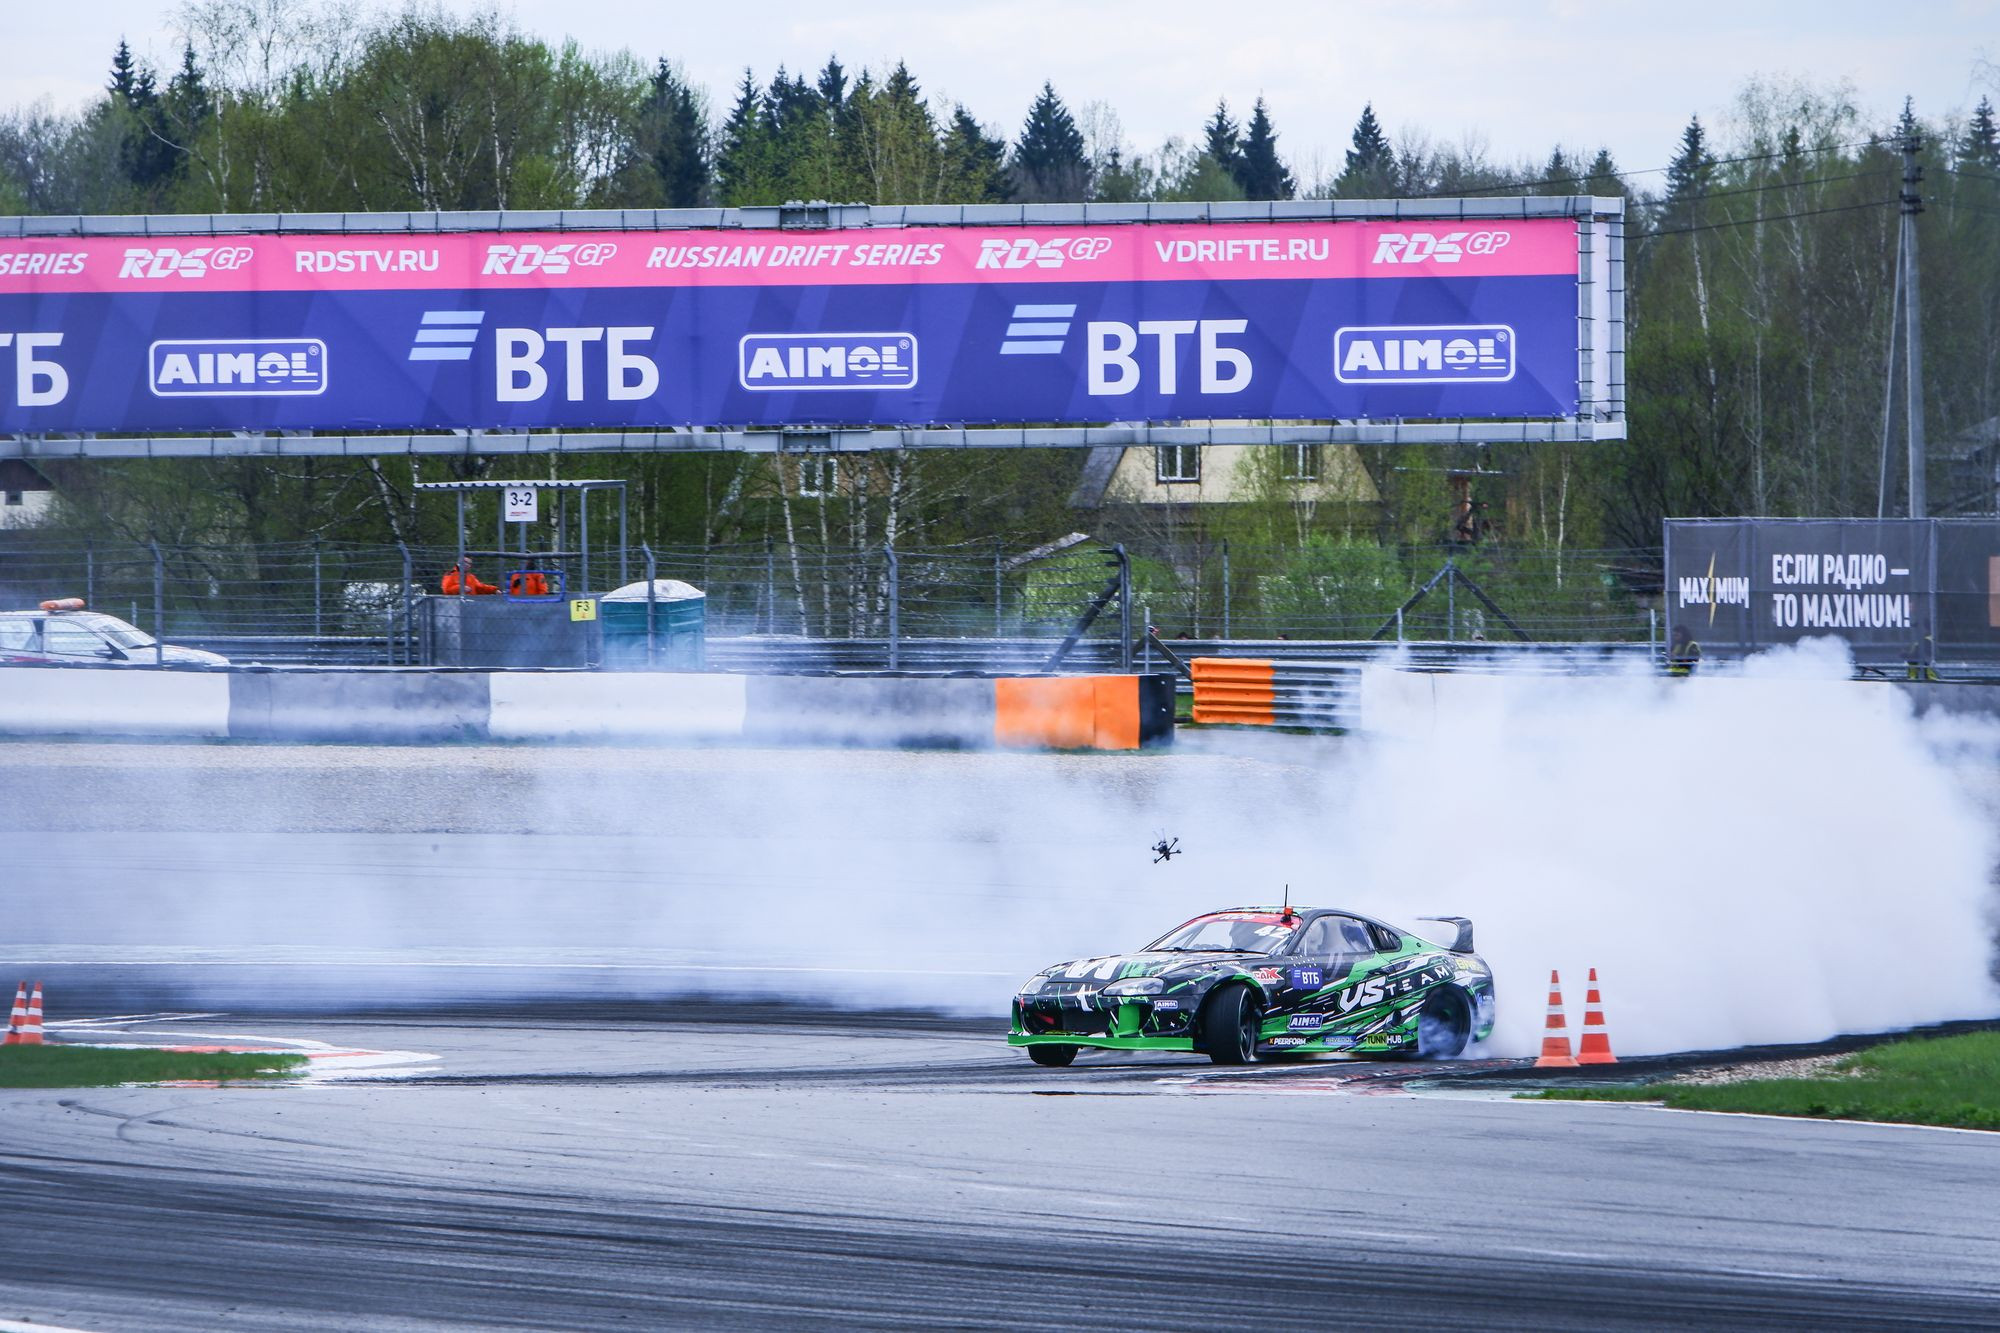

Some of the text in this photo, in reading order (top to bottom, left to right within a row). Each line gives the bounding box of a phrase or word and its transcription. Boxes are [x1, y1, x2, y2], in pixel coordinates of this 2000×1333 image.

[0, 253, 88, 275] SERIES
[296, 250, 440, 273] RDSTV.RU
[646, 243, 944, 268] RUSSIAN DRIFT SERIES
[1155, 238, 1329, 262] VDRIFTE.RU
[0, 332, 69, 407] Б
[157, 352, 318, 384] AIMOL
[496, 326, 660, 402] ВТБ
[747, 345, 909, 378] AIMOL
[1087, 319, 1253, 396] ВТБ
[1342, 338, 1506, 371] AIMOL
[510, 492, 532, 506] 3-2
[1772, 554, 1819, 585] ЕСЛИ
[1823, 554, 1887, 590] РАДИО
[576, 601, 590, 612] F3
[1773, 593, 1911, 628] ТО MAXIMUM!
[1301, 971, 1320, 985] ВТБ
[1385, 964, 1450, 996] TEAM
[1290, 1016, 1321, 1027] AIMOL
